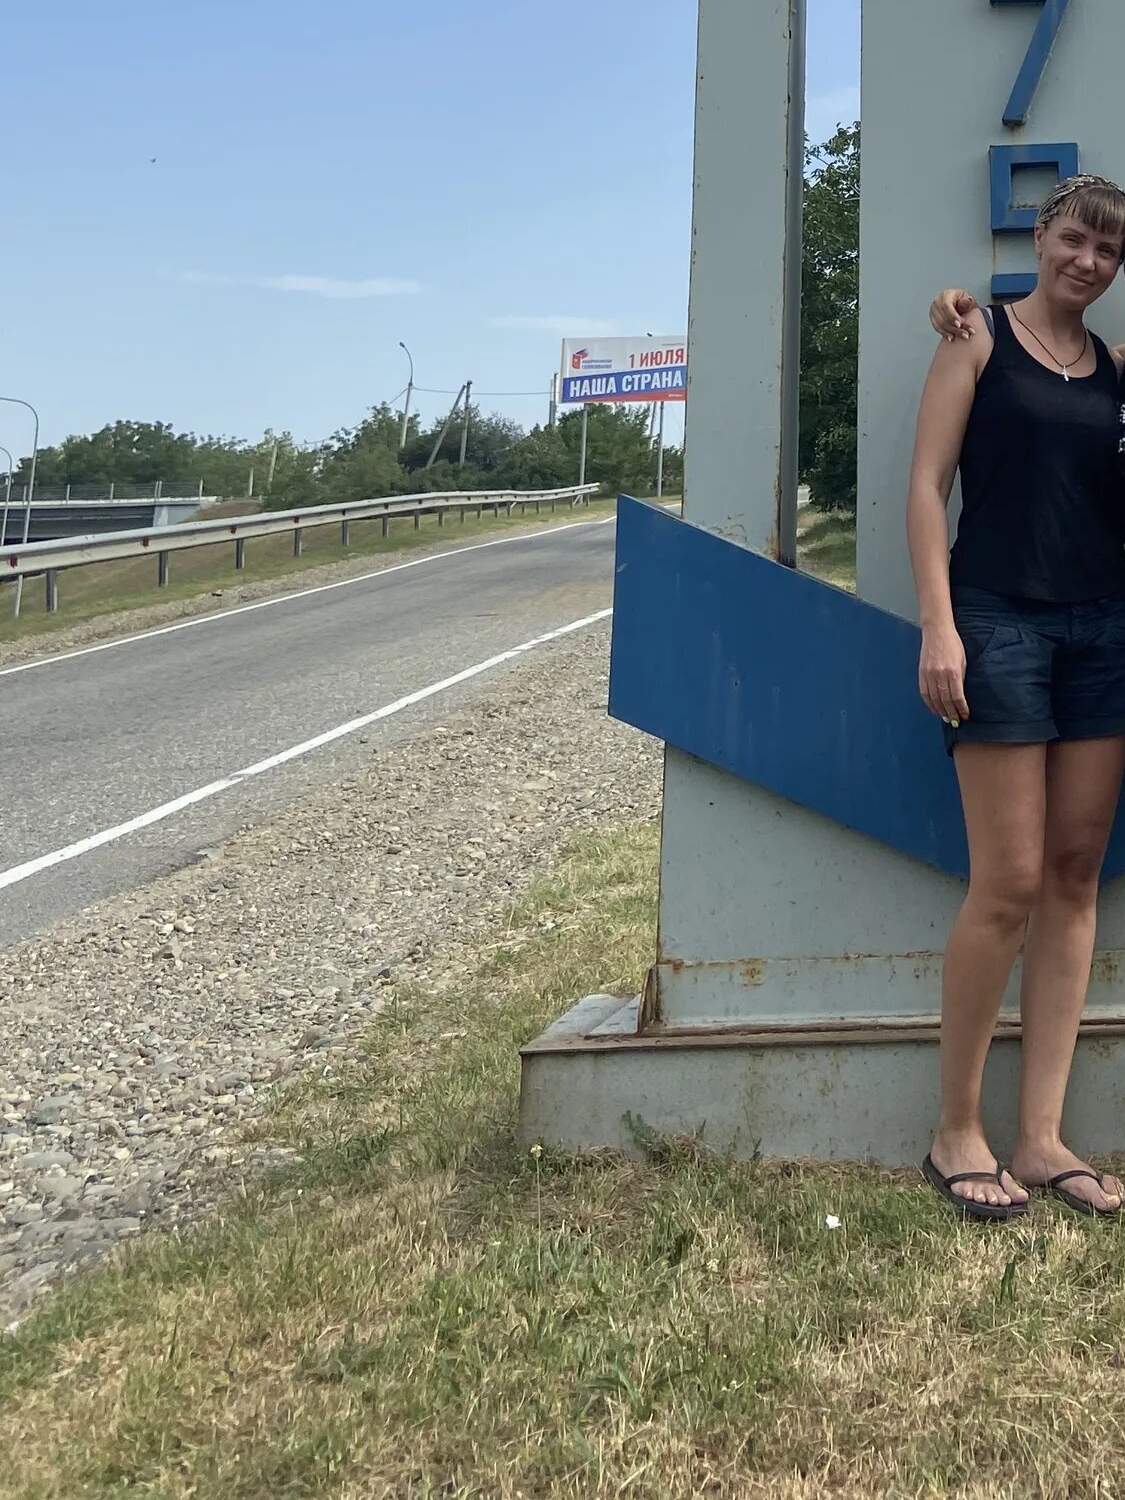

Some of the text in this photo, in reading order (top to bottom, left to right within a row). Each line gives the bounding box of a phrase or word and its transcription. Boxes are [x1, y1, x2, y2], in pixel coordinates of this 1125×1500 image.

[629, 348, 684, 368] 1 ИЮЛЯ
[569, 370, 682, 397] НАША СТРАНА
